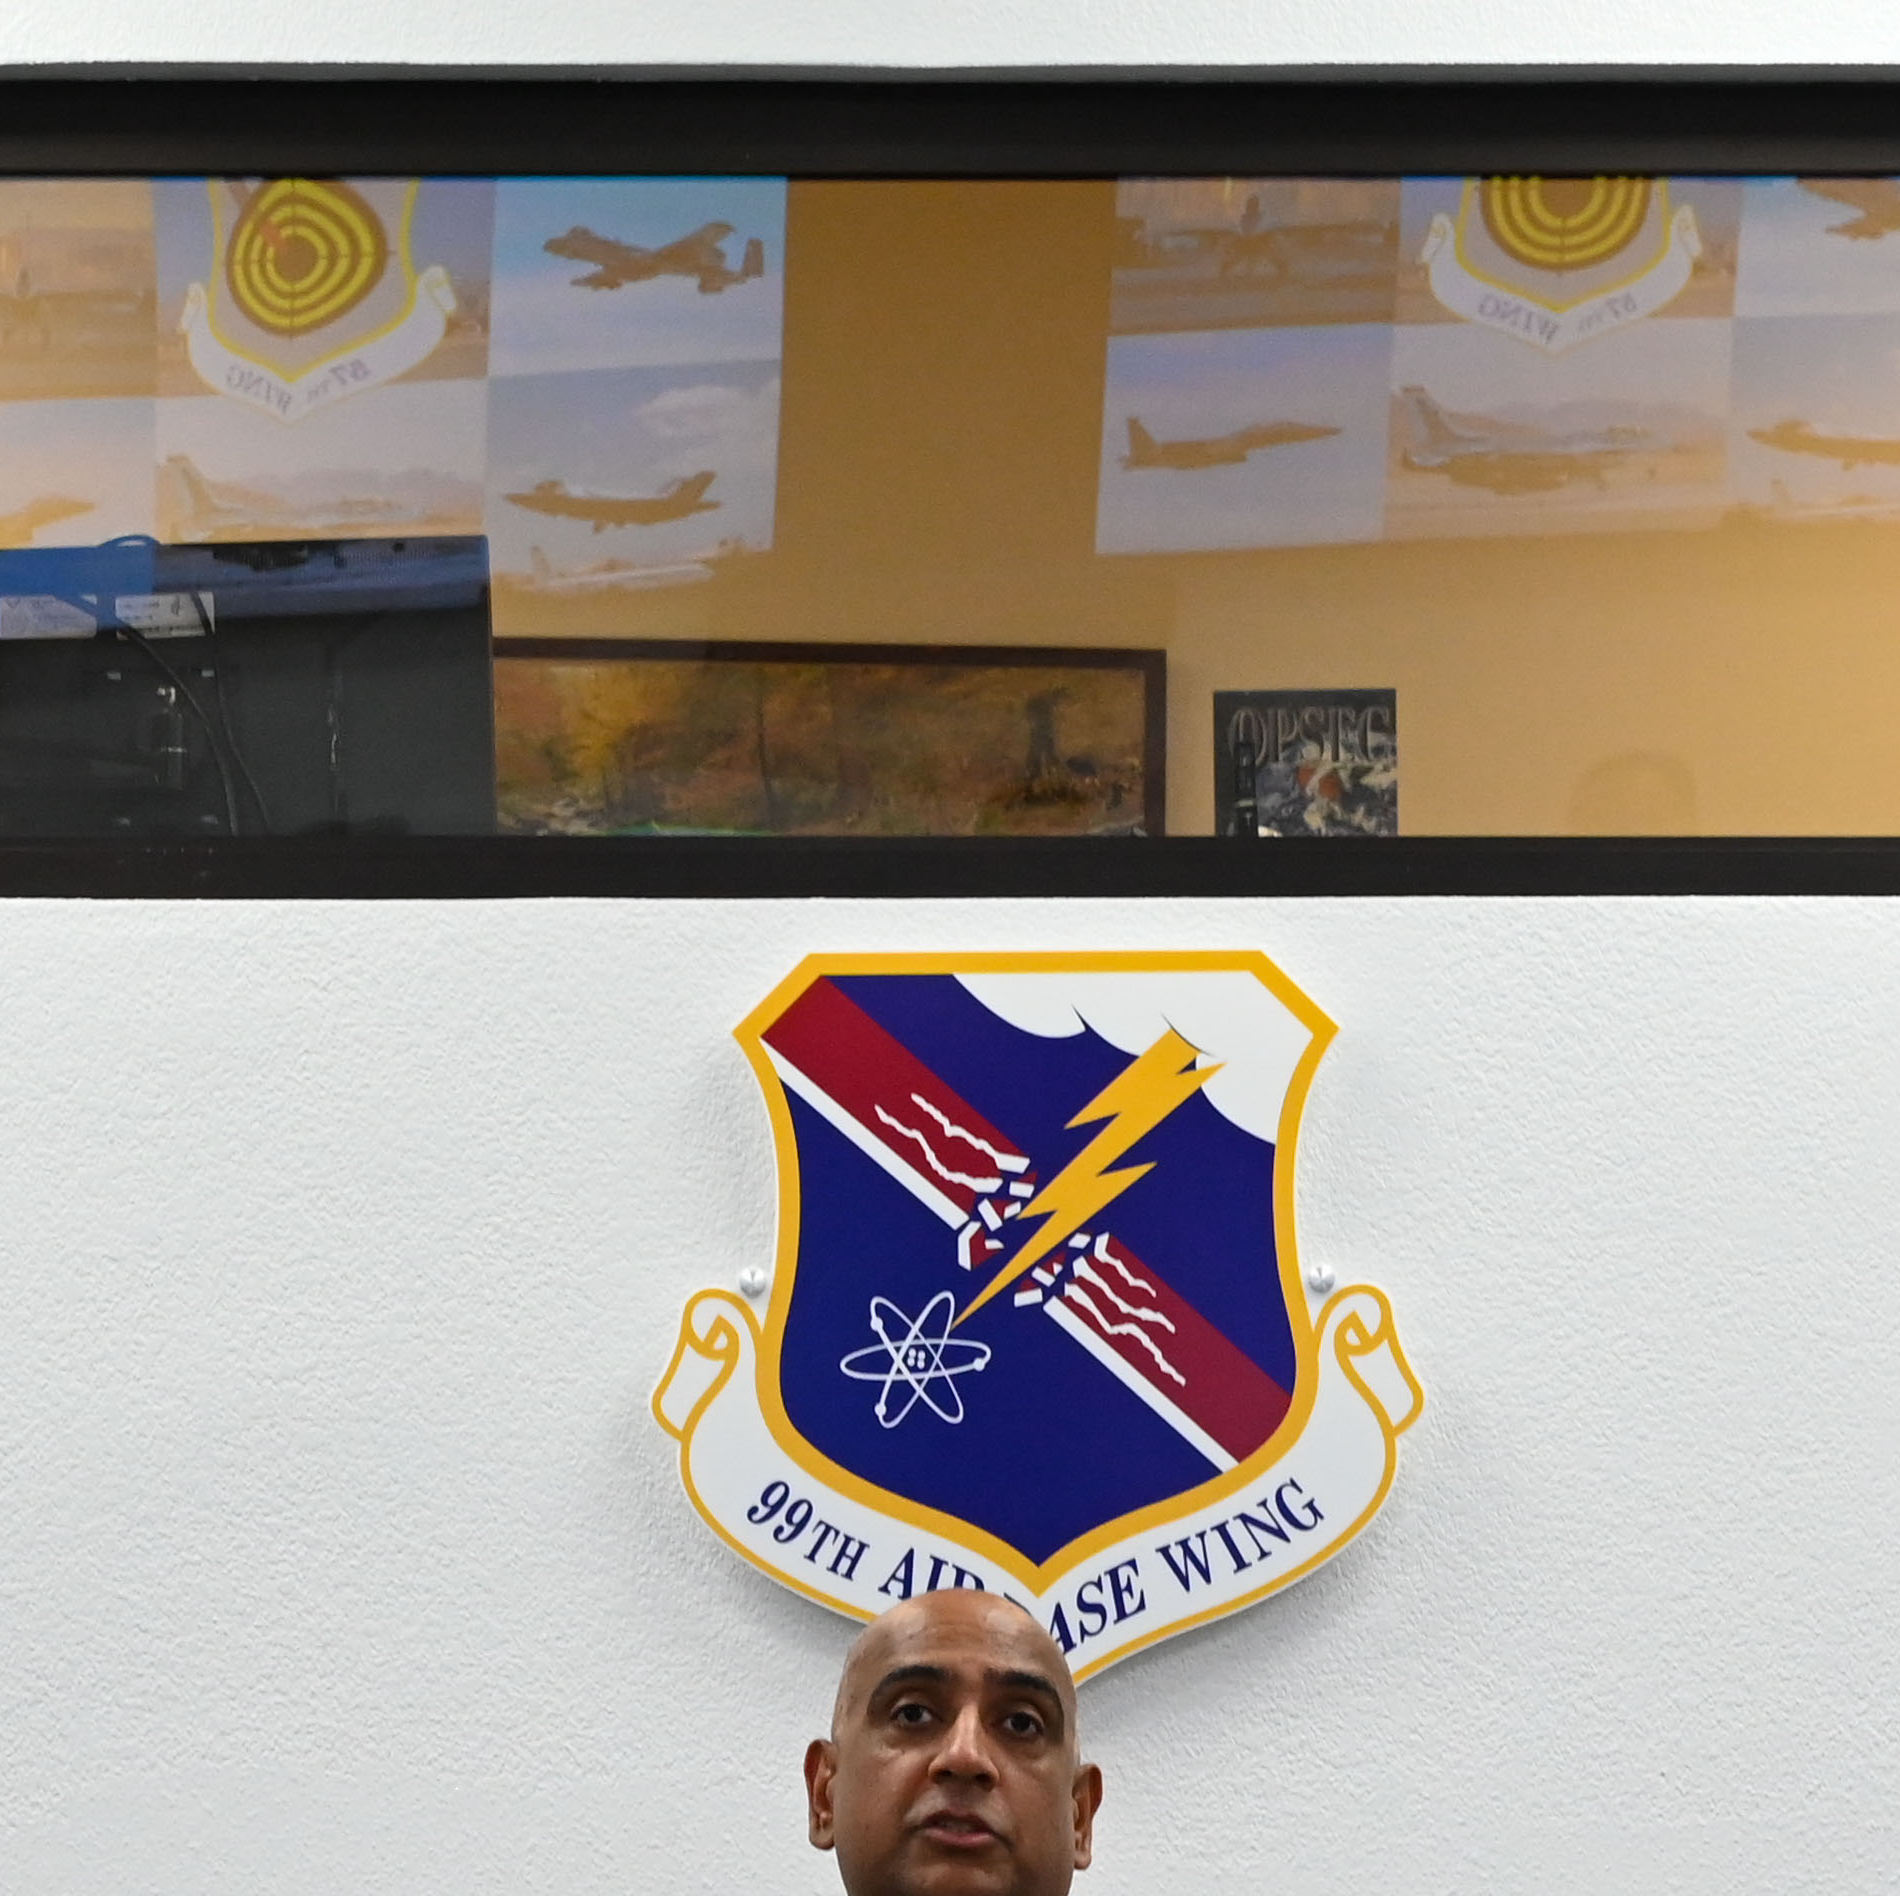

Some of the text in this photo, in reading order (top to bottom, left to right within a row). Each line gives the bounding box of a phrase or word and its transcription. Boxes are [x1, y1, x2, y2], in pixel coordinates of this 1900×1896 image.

[746, 1478, 872, 1580] 99TH
[1004, 1557, 1147, 1656] ASE
[1155, 1477, 1325, 1595] WING
